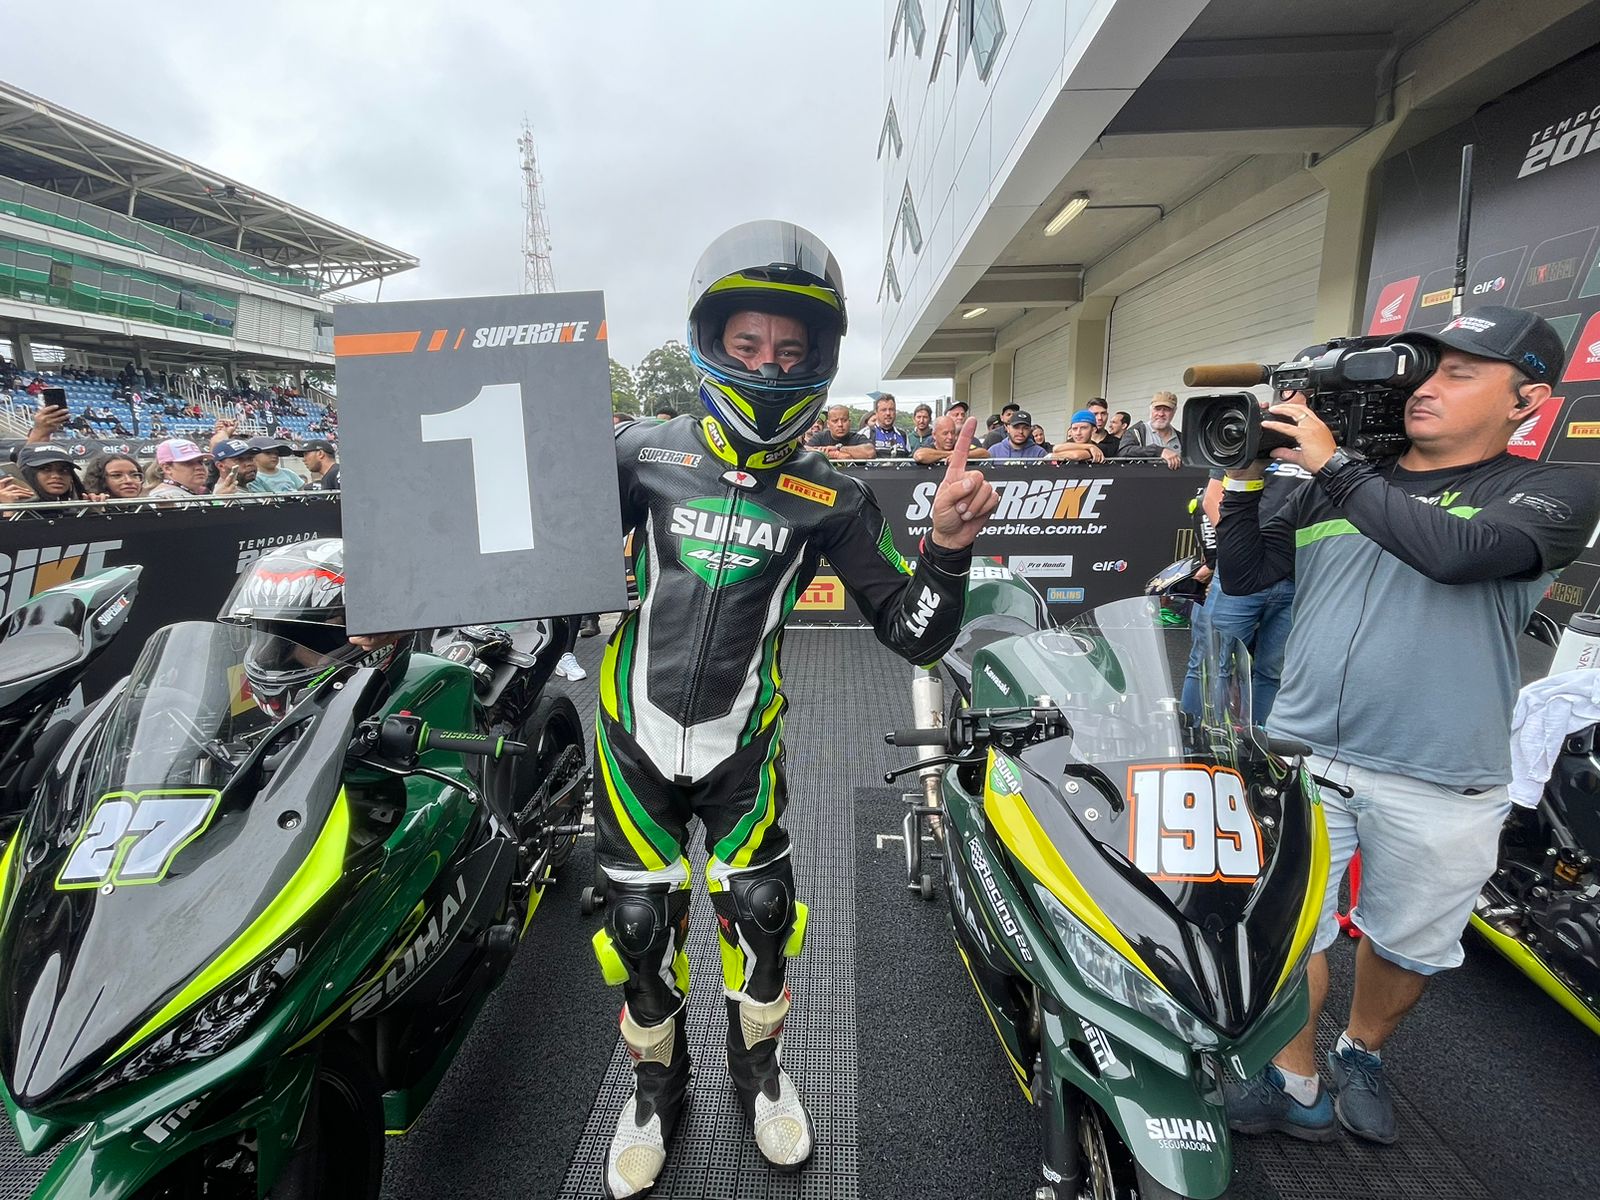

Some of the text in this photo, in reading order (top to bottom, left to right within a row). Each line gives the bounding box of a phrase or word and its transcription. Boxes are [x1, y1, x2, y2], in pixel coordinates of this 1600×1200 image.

[1472, 279, 1494, 295] elf
[472, 321, 590, 349] SUPERBIKE
[707, 422, 727, 452] 2MT
[420, 382, 535, 554] 1
[639, 447, 702, 468] SUPERBIKE
[763, 445, 791, 465] 2MT
[782, 477, 833, 502] PIRELLI
[238, 531, 319, 550] TEMPORADA
[670, 506, 790, 553] SUHAI
[686, 549, 760, 568] 400
[1092, 559, 1114, 572] elf
[906, 585, 941, 639] 2MT
[984, 664, 1010, 696] Kawasaki
[994, 757, 1023, 796] SUHAI
[1131, 767, 1263, 879] 199
[60, 796, 215, 885] 27
[976, 864, 1033, 962] Racing 22
[349, 873, 467, 1023] SUHAI
[1145, 1117, 1217, 1144] SUHAI
[1158, 1139, 1213, 1153] SEGURADORA
